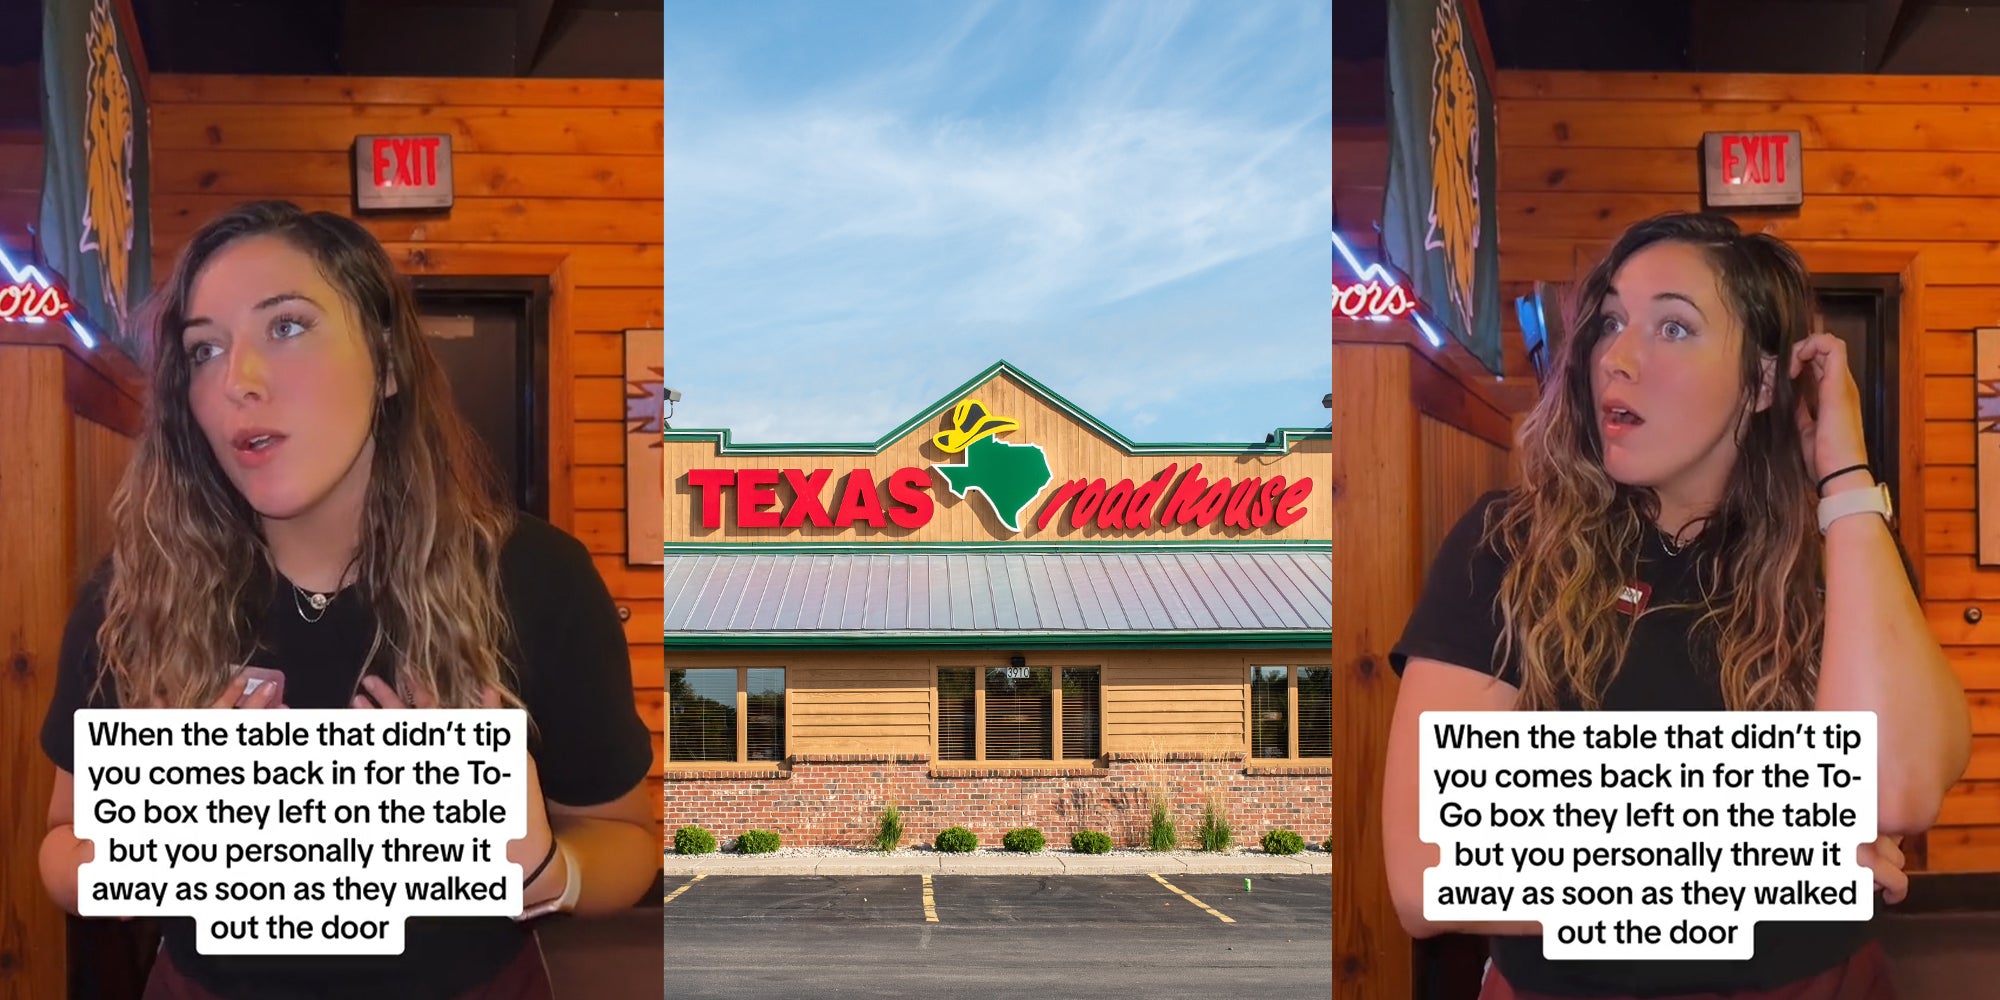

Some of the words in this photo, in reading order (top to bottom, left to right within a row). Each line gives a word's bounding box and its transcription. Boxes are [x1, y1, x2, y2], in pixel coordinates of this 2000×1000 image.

[373, 137, 440, 187] EXIT
[1722, 135, 1789, 185] EXIT
[687, 466, 935, 531] TEXAS
[1036, 462, 1313, 532] roadhouse
[1007, 667, 1029, 678] 3910
